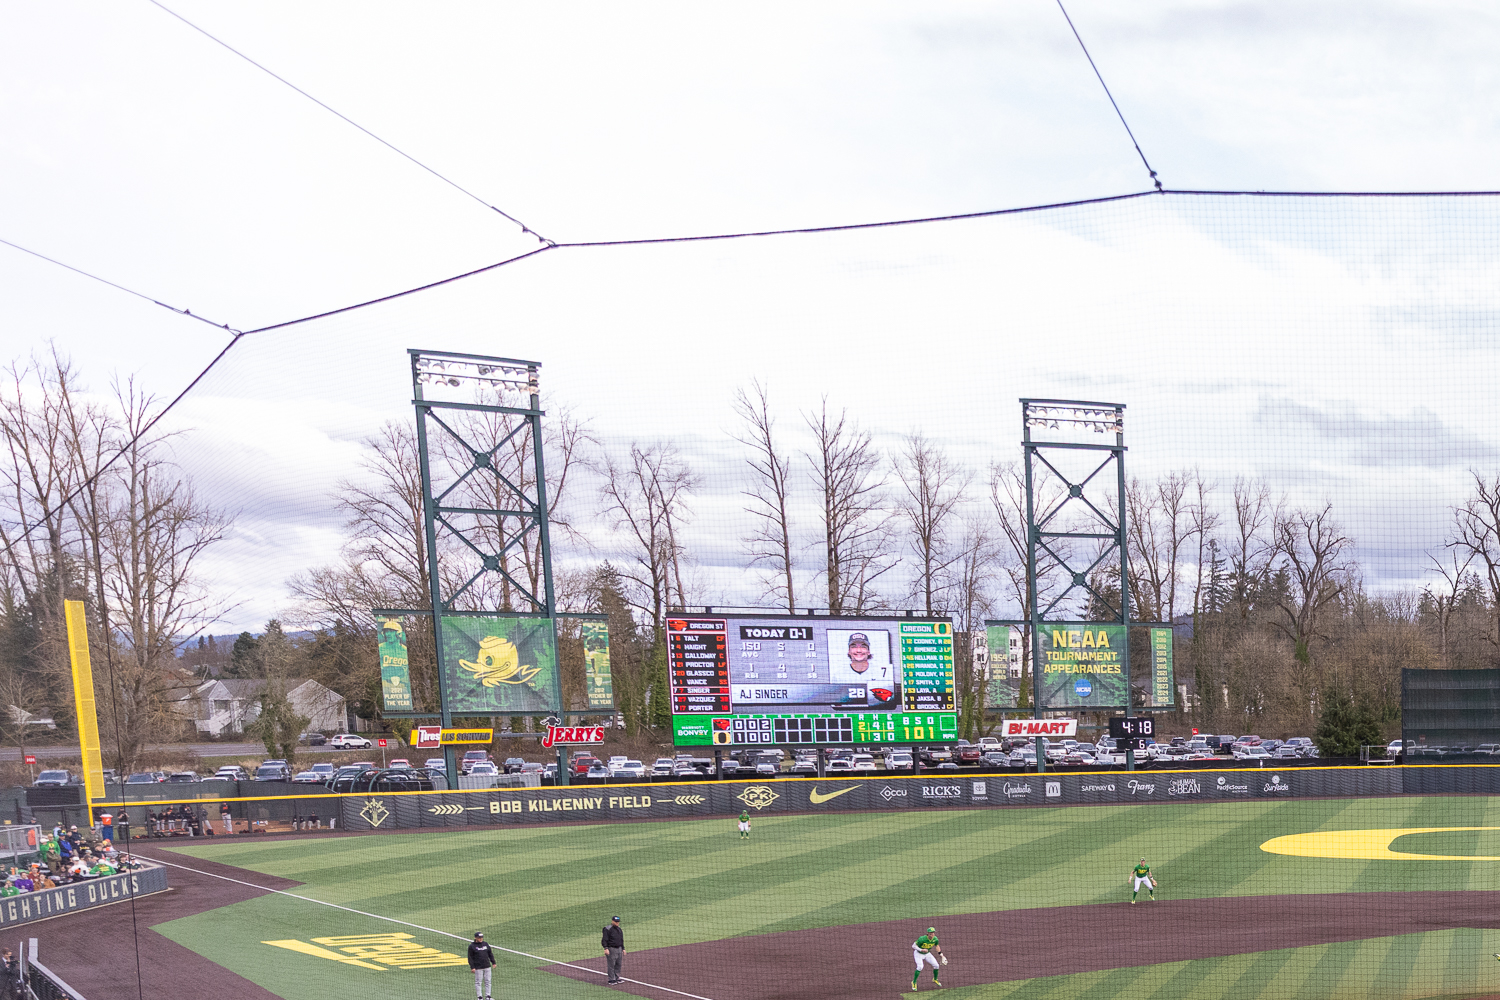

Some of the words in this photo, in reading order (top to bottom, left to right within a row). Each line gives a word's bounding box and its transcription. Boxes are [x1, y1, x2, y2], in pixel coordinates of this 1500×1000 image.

[745, 628, 786, 638] TODAY
[789, 628, 806, 639] 0-1
[1052, 630, 1110, 648] NCAA
[990, 654, 1008, 662] 1954
[1046, 652, 1118, 661] TOURNAMENT
[880, 667, 887, 678] 7
[1044, 664, 1121, 674] APPEARANCES
[740, 689, 752, 698] AJ
[755, 689, 788, 699] SINGER
[848, 688, 866, 698] 28
[734, 720, 742, 728] 0
[748, 720, 756, 728] 0
[762, 720, 770, 728] 2
[858, 722, 866, 730] 2
[872, 721, 880, 730] 4
[887, 721, 894, 730] 0
[902, 716, 910, 725] B
[914, 716, 922, 725] S
[1122, 720, 1152, 734] 4:18
[420, 729, 440, 742] Tires
[442, 732, 455, 741] LES
[542, 724, 604, 748] JERRY'S
[737, 733, 742, 742] 1
[749, 733, 757, 742] 0
[762, 733, 770, 742] 0
[860, 732, 865, 742] 1
[873, 732, 880, 741] 3
[888, 732, 894, 741] 0
[904, 726, 910, 740] 1
[914, 726, 924, 740] 0
[928, 726, 934, 740] 1
[1139, 740, 1145, 748] 6
[922, 786, 960, 796] RICK'S
[1003, 782, 1032, 798] Graduate
[1128, 780, 1155, 794] Franz
[1177, 784, 1200, 794] BEAN
[1264, 783, 1288, 792] Surfside
[748, 792, 769, 800] PK
[884, 789, 907, 798] OCCU
[490, 800, 522, 814] BOB
[528, 798, 602, 812] KILKENNY
[609, 796, 651, 808] FIELD
[88, 876, 139, 902] DUCKS
